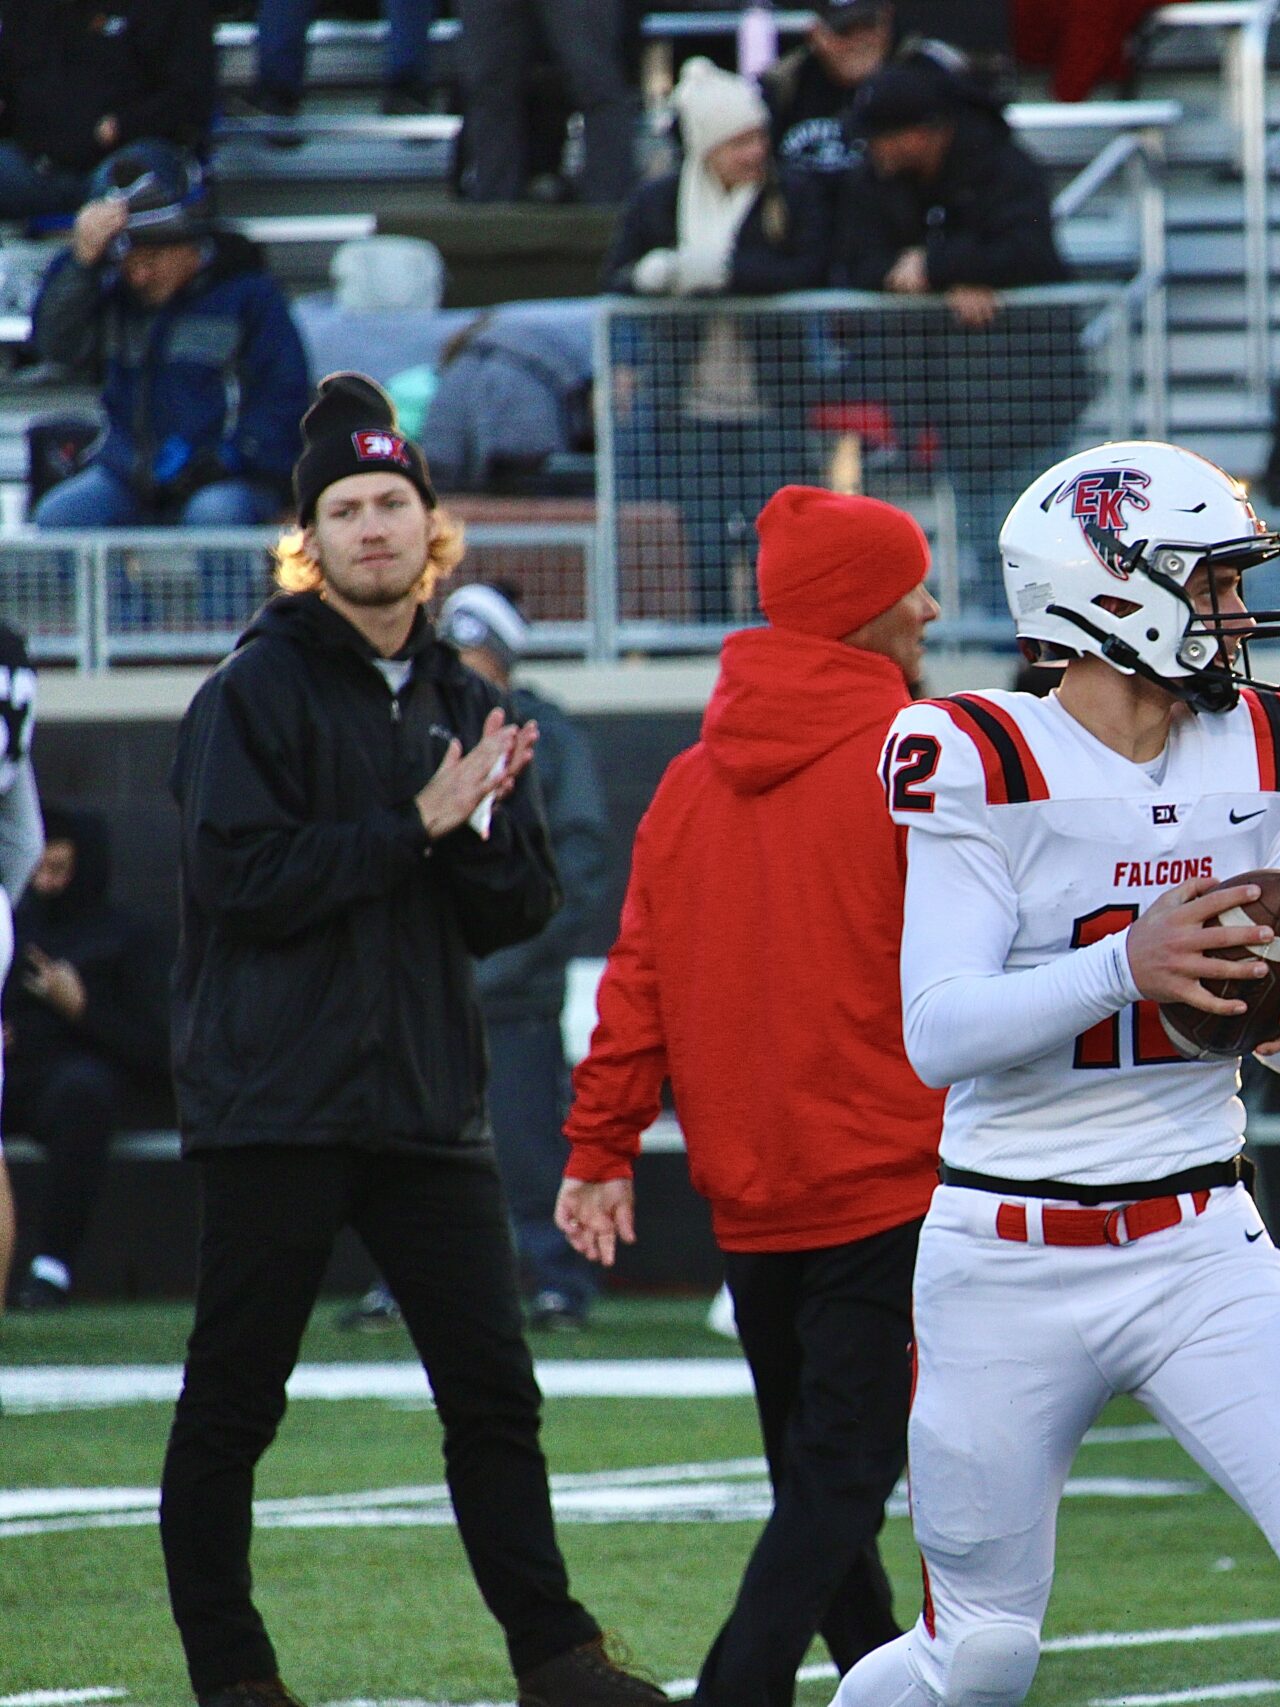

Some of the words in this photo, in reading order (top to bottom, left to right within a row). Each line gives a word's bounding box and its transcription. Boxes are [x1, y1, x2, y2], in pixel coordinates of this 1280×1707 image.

[1073, 478, 1128, 530] EK
[882, 733, 942, 813] 12
[1113, 856, 1213, 887] FALCONS
